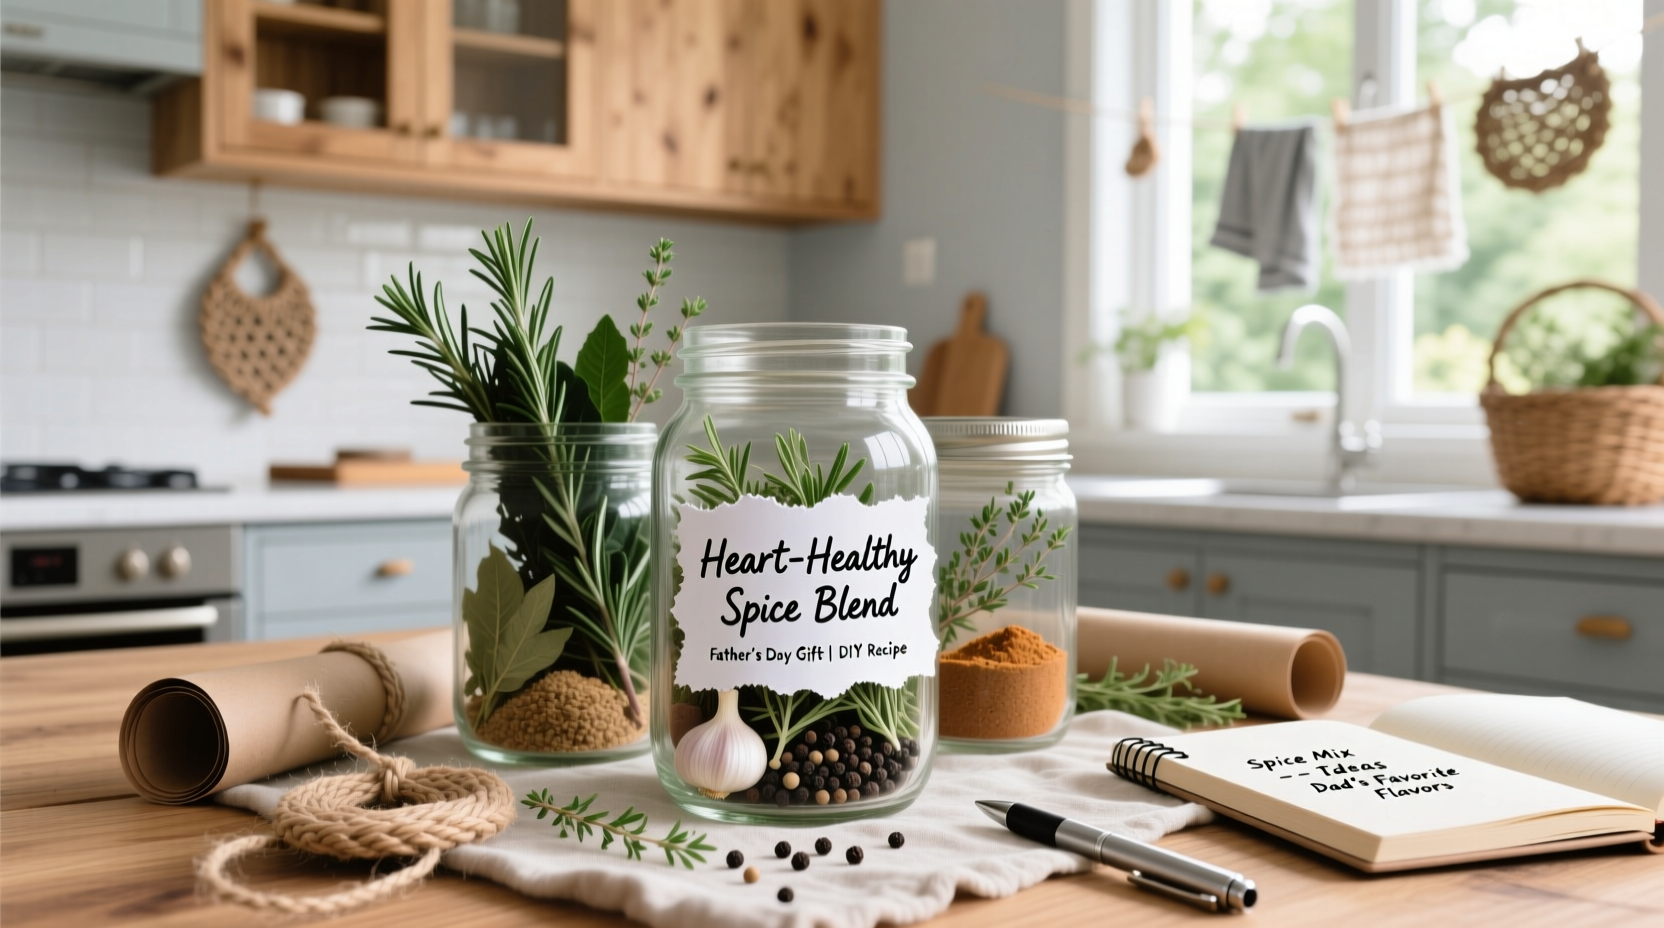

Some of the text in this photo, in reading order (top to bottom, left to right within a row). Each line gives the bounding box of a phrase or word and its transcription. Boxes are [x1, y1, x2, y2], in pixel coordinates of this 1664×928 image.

[700, 533, 918, 583] Heart-Healthy
[720, 582, 899, 638] Spice Blend
[709, 647, 762, 662] Father's
[766, 647, 792, 665] Day
[796, 645, 825, 662] Gift
[839, 643, 863, 659] DIY
[867, 641, 908, 660] Recipe
[1246, 748, 1355, 772] Spice Mix
[1310, 767, 1460, 793] Dad's Favorite
[1374, 782, 1455, 800] Flavors
